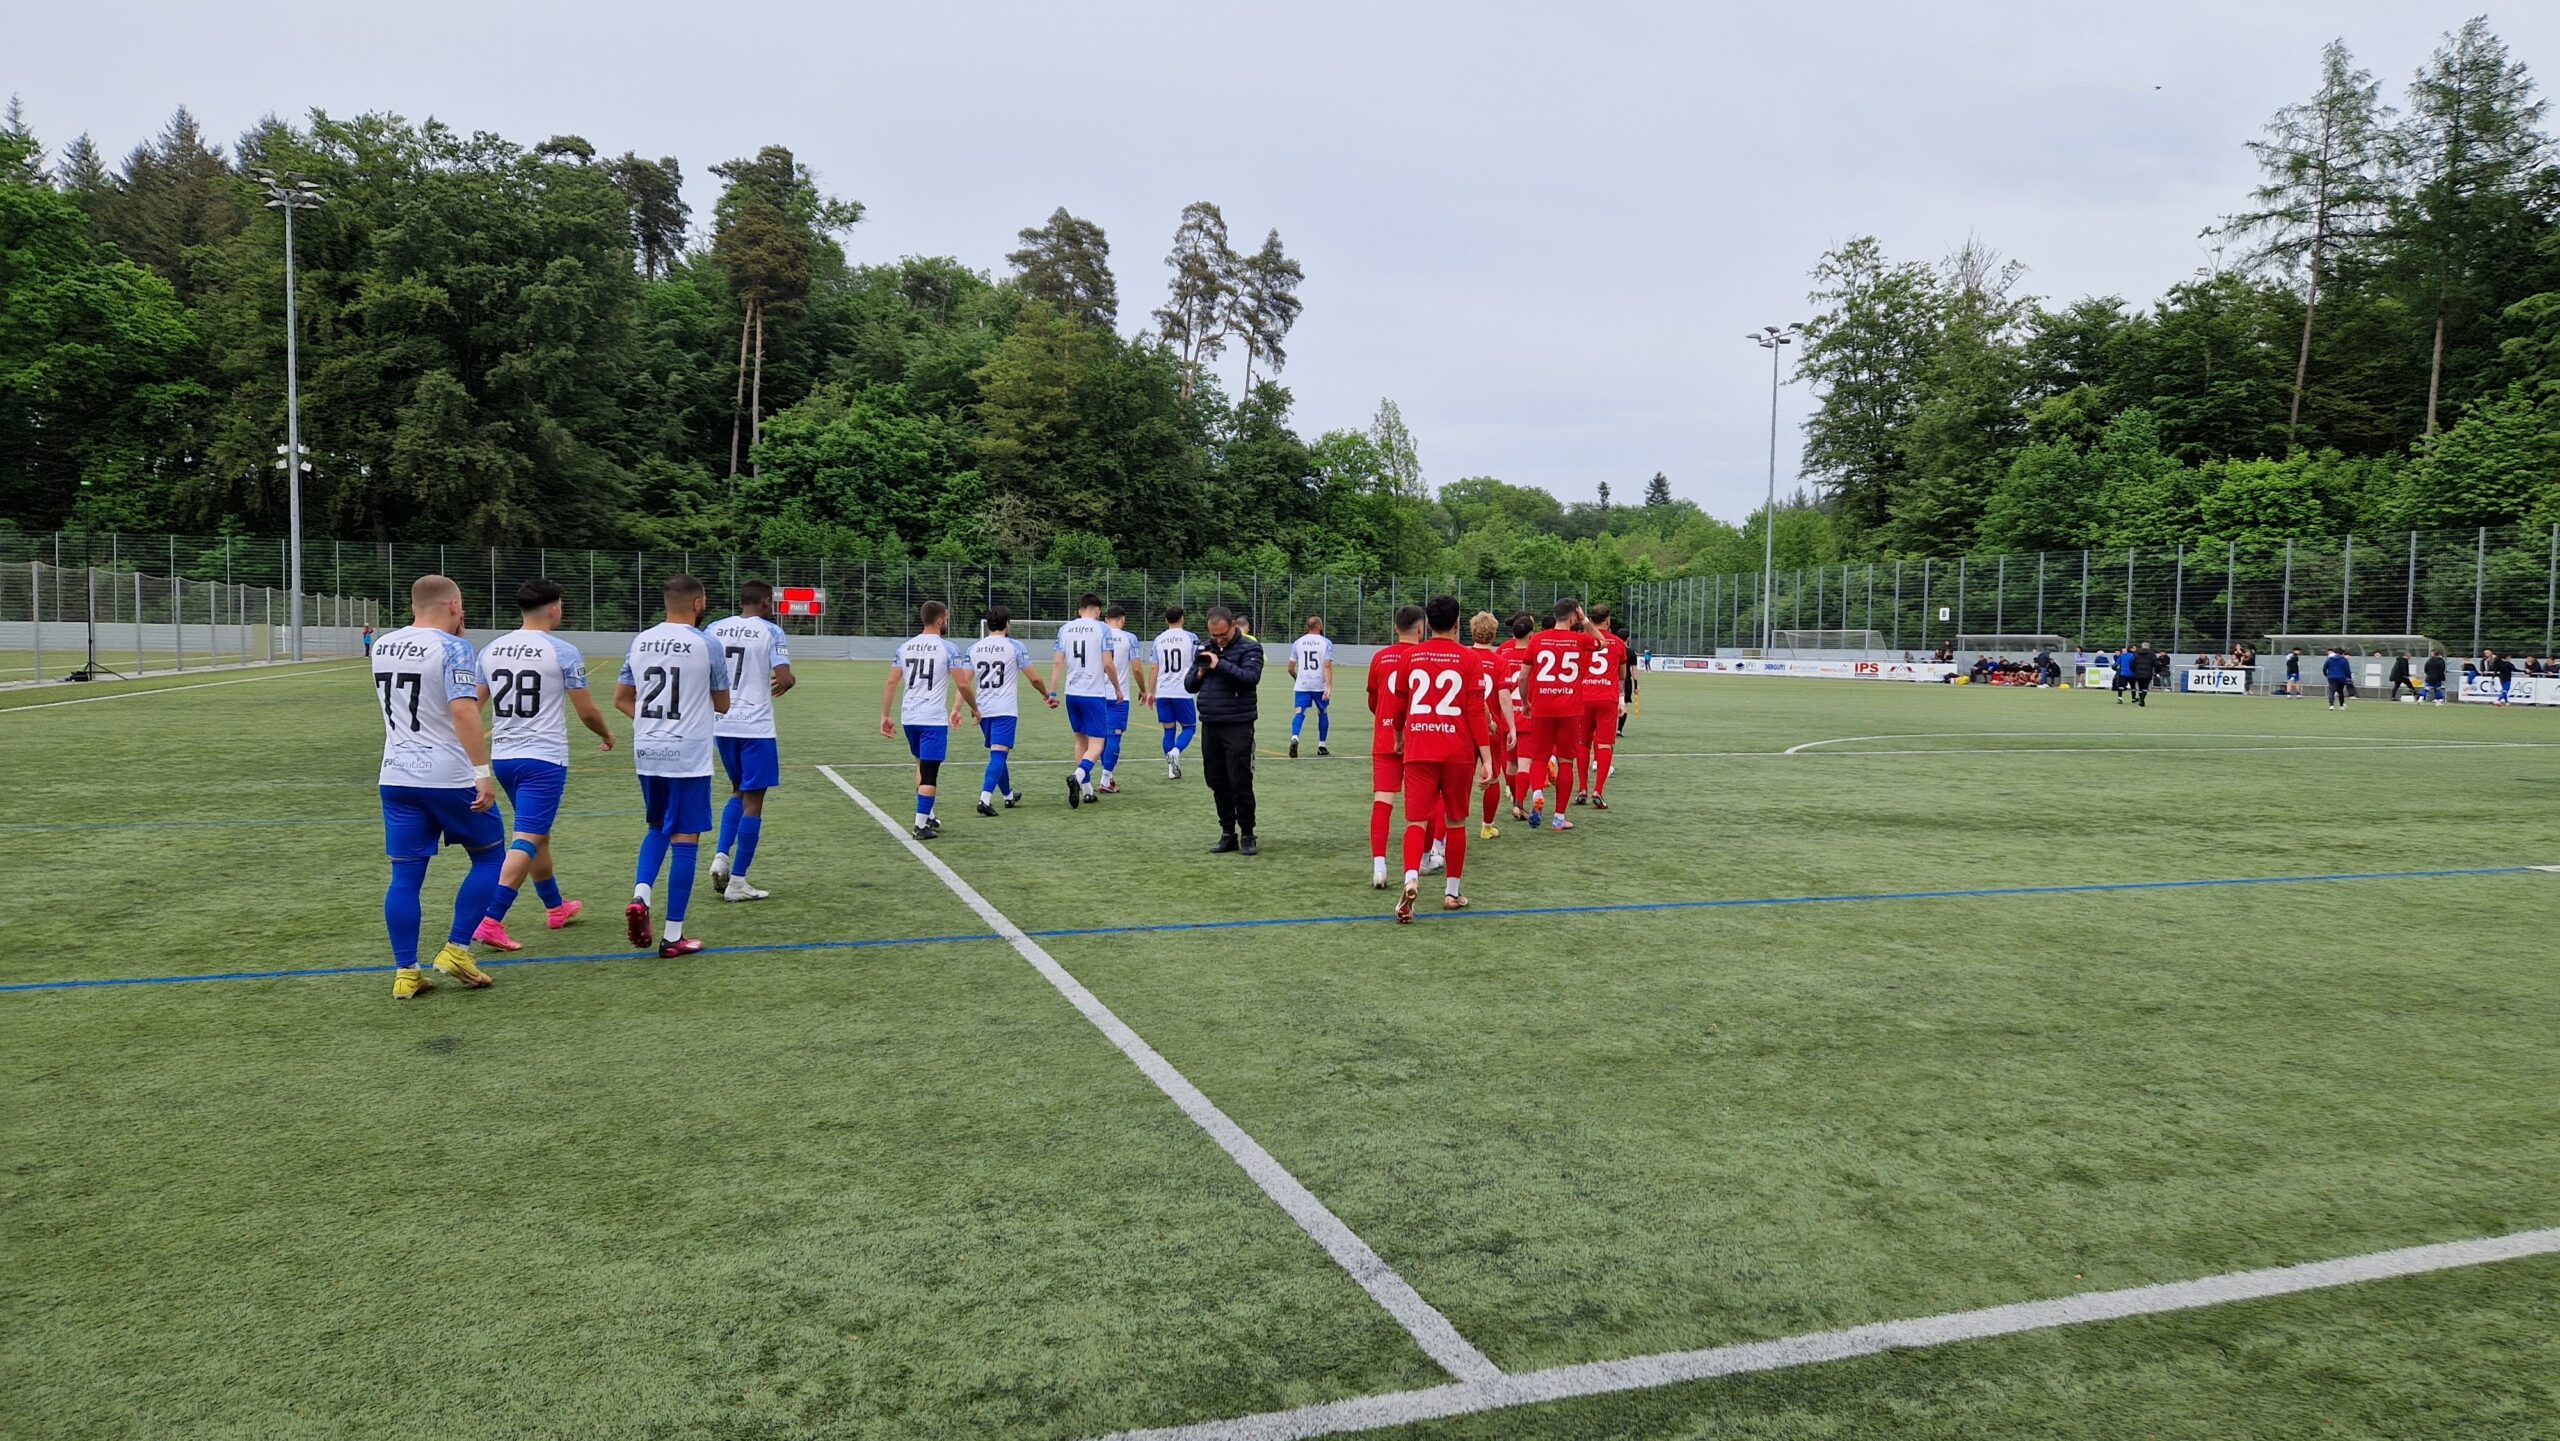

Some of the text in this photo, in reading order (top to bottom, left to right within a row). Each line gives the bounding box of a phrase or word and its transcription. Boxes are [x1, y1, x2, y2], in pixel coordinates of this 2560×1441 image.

[716, 626, 760, 639] artifex
[1067, 626, 1094, 634] artifex
[376, 641, 427, 660] artifex
[492, 644, 543, 660] artifex
[640, 639, 692, 655] artifex
[907, 643, 937, 652] artifex
[976, 644, 1005, 654] artifex
[1073, 640, 1086, 668] 4
[725, 646, 746, 690] 7
[1163, 648, 1182, 673] 10
[1303, 650, 1319, 671] 15
[1536, 650, 1580, 683] 25
[1588, 648, 1609, 675] 5
[1855, 663, 1879, 673] IPS
[905, 658, 935, 691] 74
[977, 660, 1006, 689] 23
[2193, 671, 2238, 688] artifex
[491, 668, 542, 719] 28
[640, 666, 682, 720] 21
[1408, 668, 1463, 717] 22
[1539, 686, 1574, 695] senevita
[2511, 681, 2532, 695] AG
[374, 672, 422, 733] 77
[1410, 722, 1456, 734] senevita
